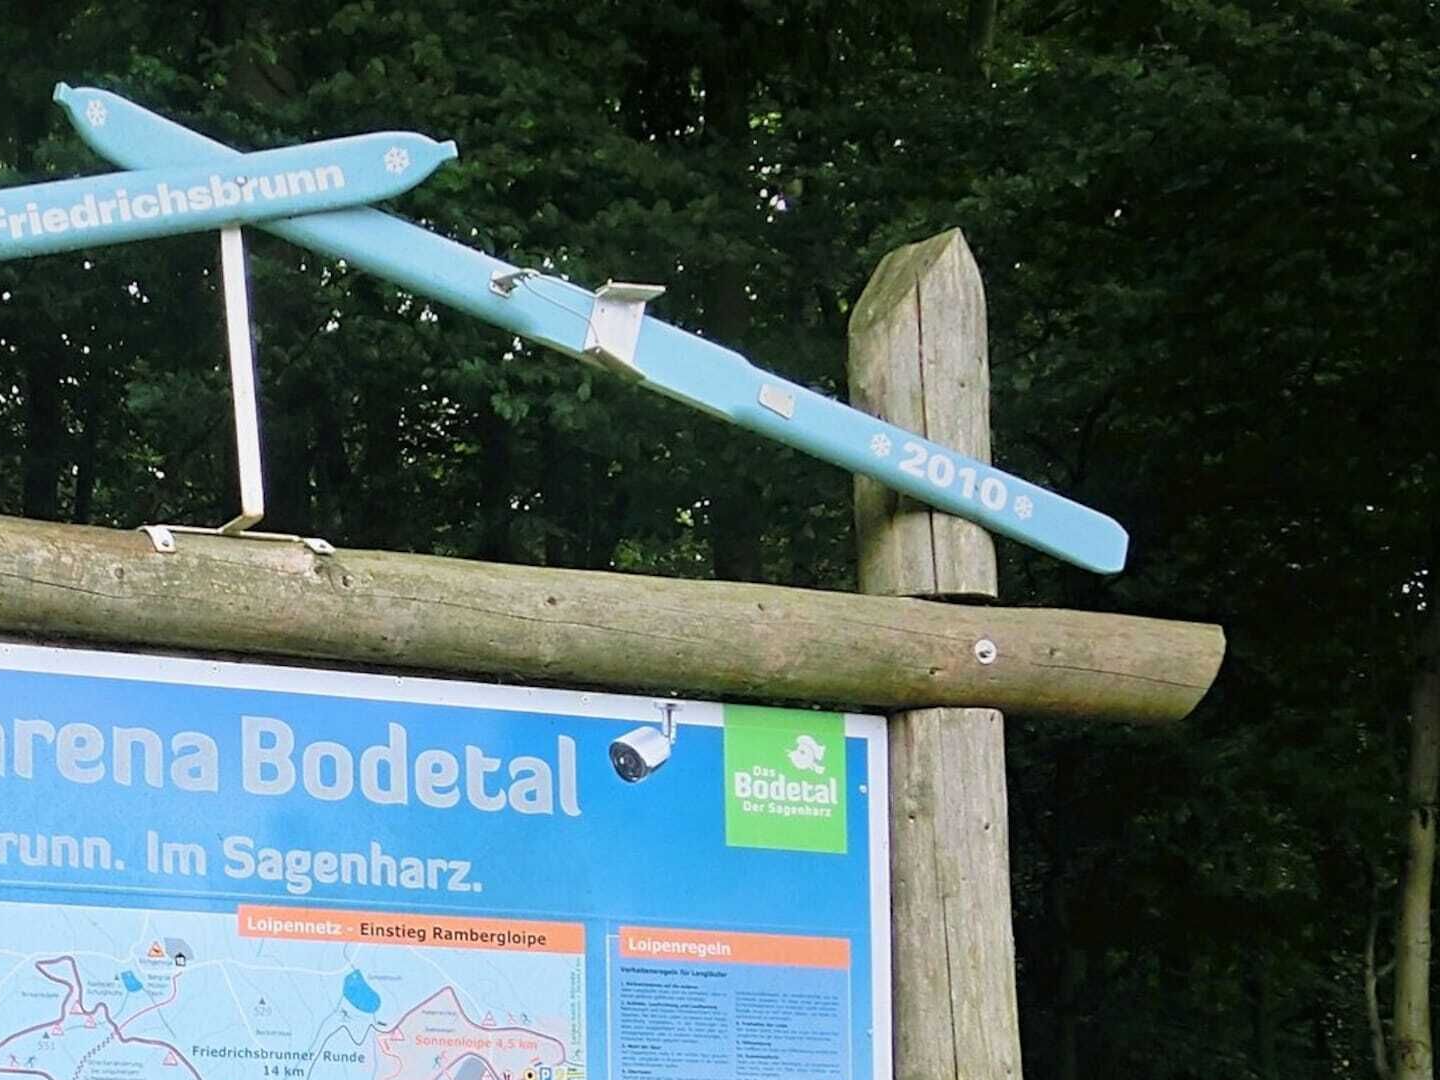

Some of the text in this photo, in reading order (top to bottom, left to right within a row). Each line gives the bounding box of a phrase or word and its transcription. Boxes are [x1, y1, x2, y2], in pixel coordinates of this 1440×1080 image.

[898, 441, 1008, 511] 2010
[241, 715, 582, 817] Bodetal
[752, 766, 777, 777] Das
[734, 771, 838, 804] Bodetal
[742, 801, 833, 817] Der Sagenharz
[146, 831, 207, 878] Im
[222, 836, 482, 894] Sagenharz.
[246, 916, 342, 938] Loipennetz
[359, 922, 426, 942] Einstieg
[432, 926, 547, 948] Rambergloipe
[628, 937, 732, 957] Loipenregeln
[415, 1034, 538, 1050] Sonnenloipe 4,5 km
[192, 1046, 366, 1063] Friedrichsbrunner Runde
[263, 1065, 305, 1077] 14 km
